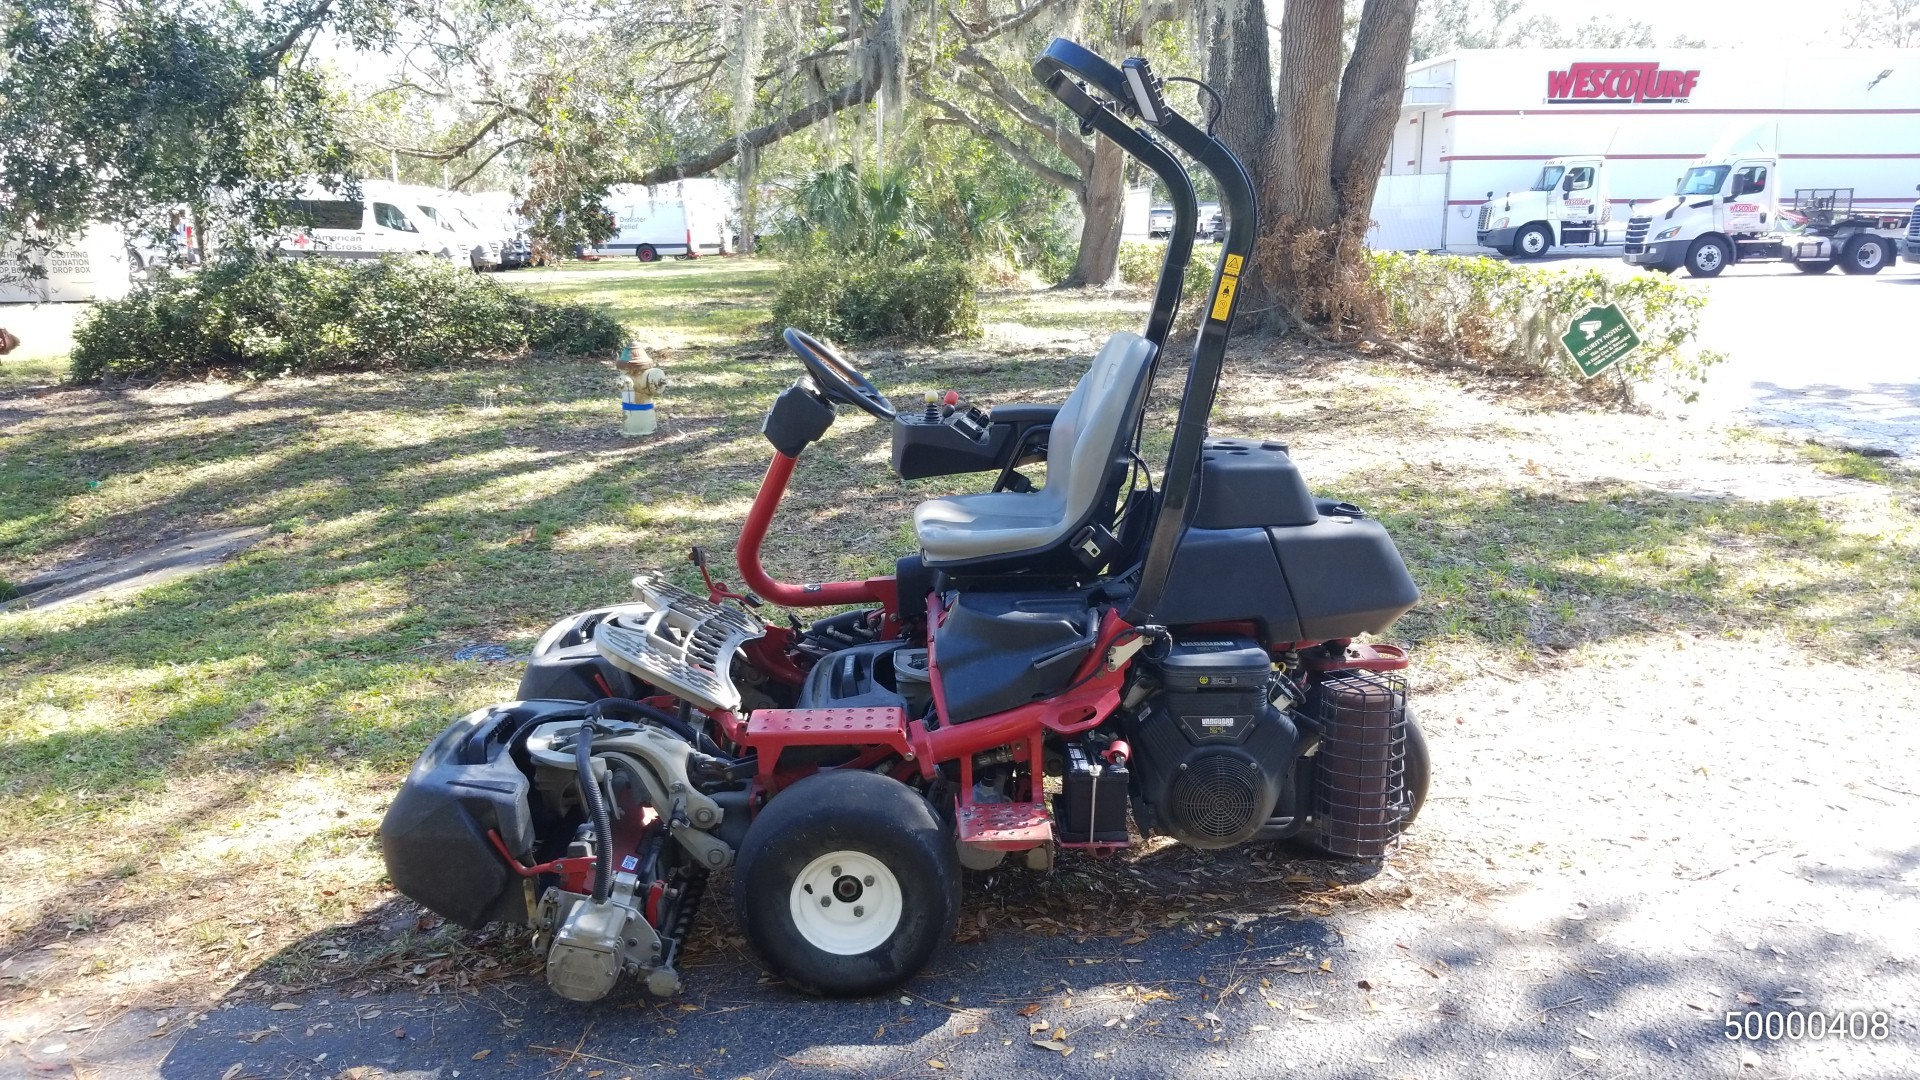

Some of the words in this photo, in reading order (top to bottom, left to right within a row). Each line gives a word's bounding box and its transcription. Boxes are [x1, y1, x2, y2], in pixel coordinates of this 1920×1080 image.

[315, 234, 362, 242] American
[1577, 337, 1604, 357] SECURITY
[1603, 323, 1625, 340] NOTICE
